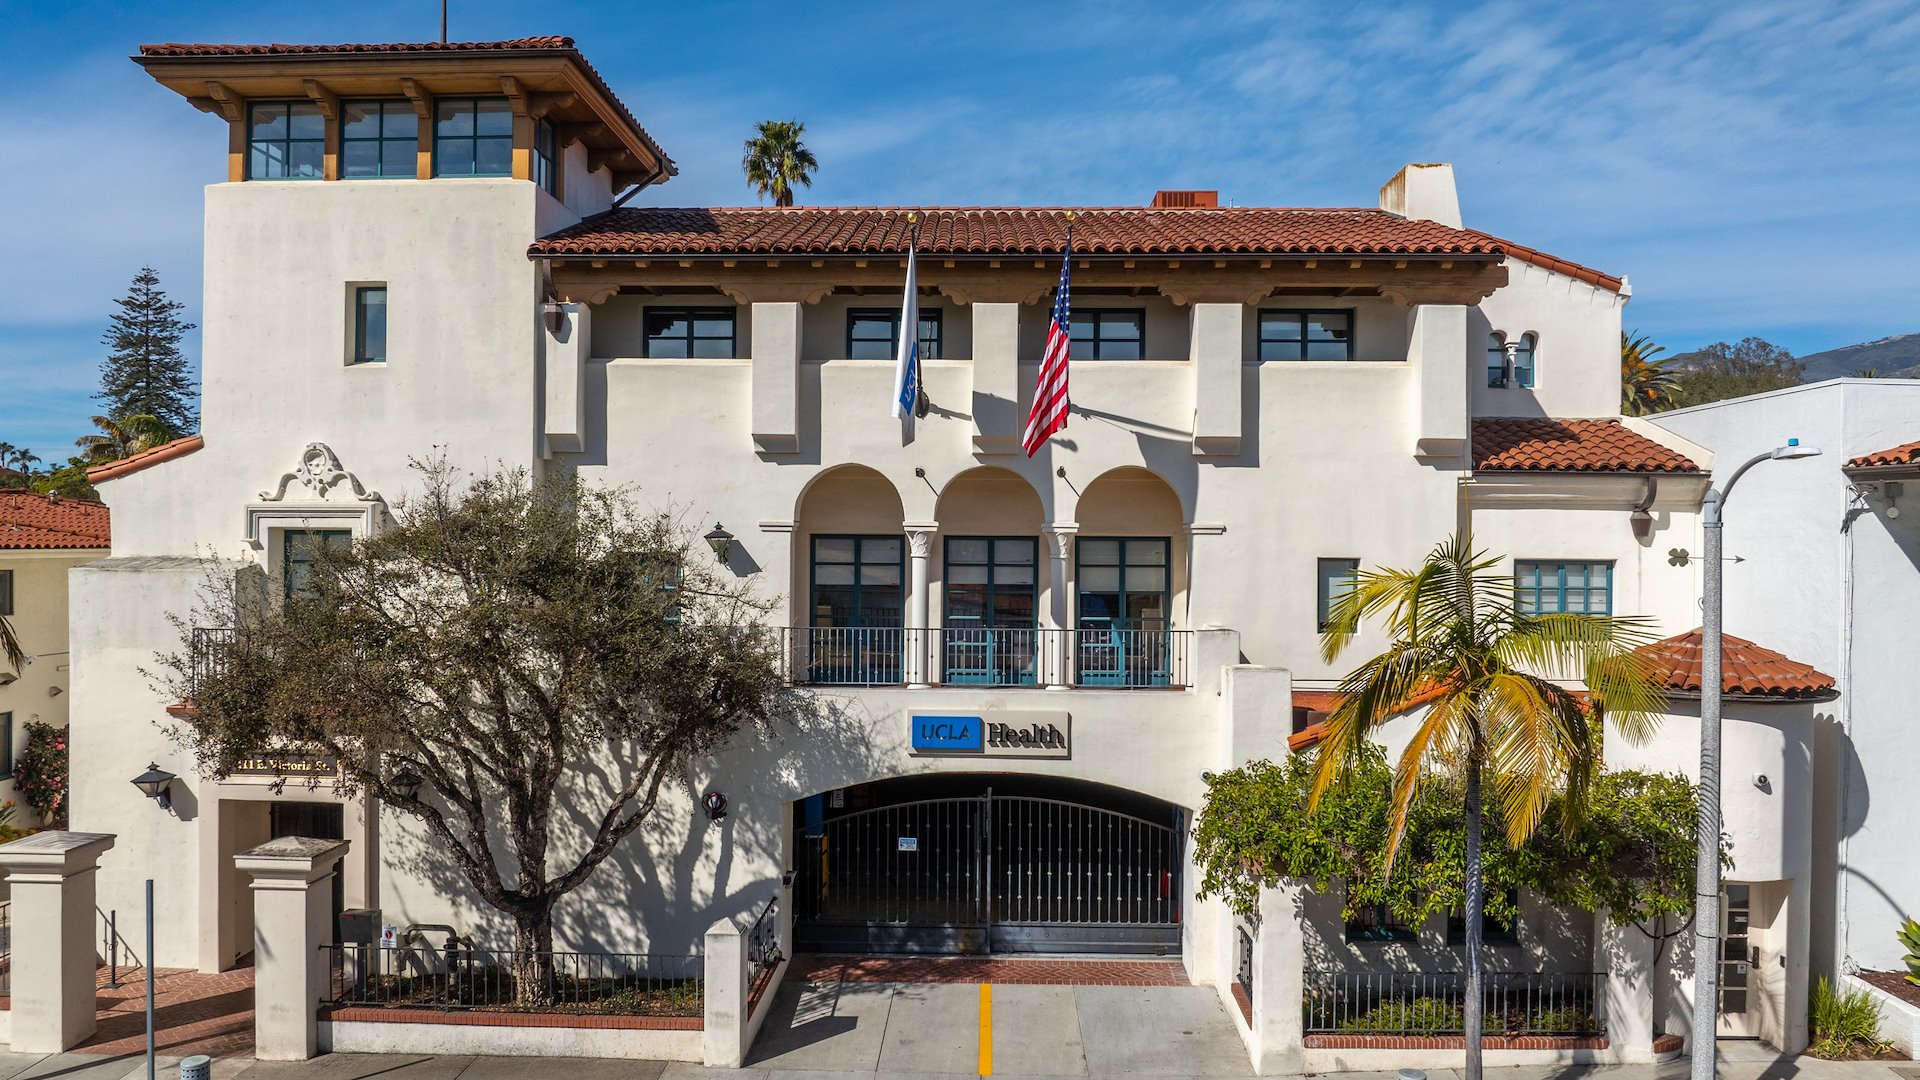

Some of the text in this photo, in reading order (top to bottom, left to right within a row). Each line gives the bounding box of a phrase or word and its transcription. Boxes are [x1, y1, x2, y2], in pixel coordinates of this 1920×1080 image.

[921, 722, 1062, 744] UCLA Health
[315, 760, 331, 771] St.
